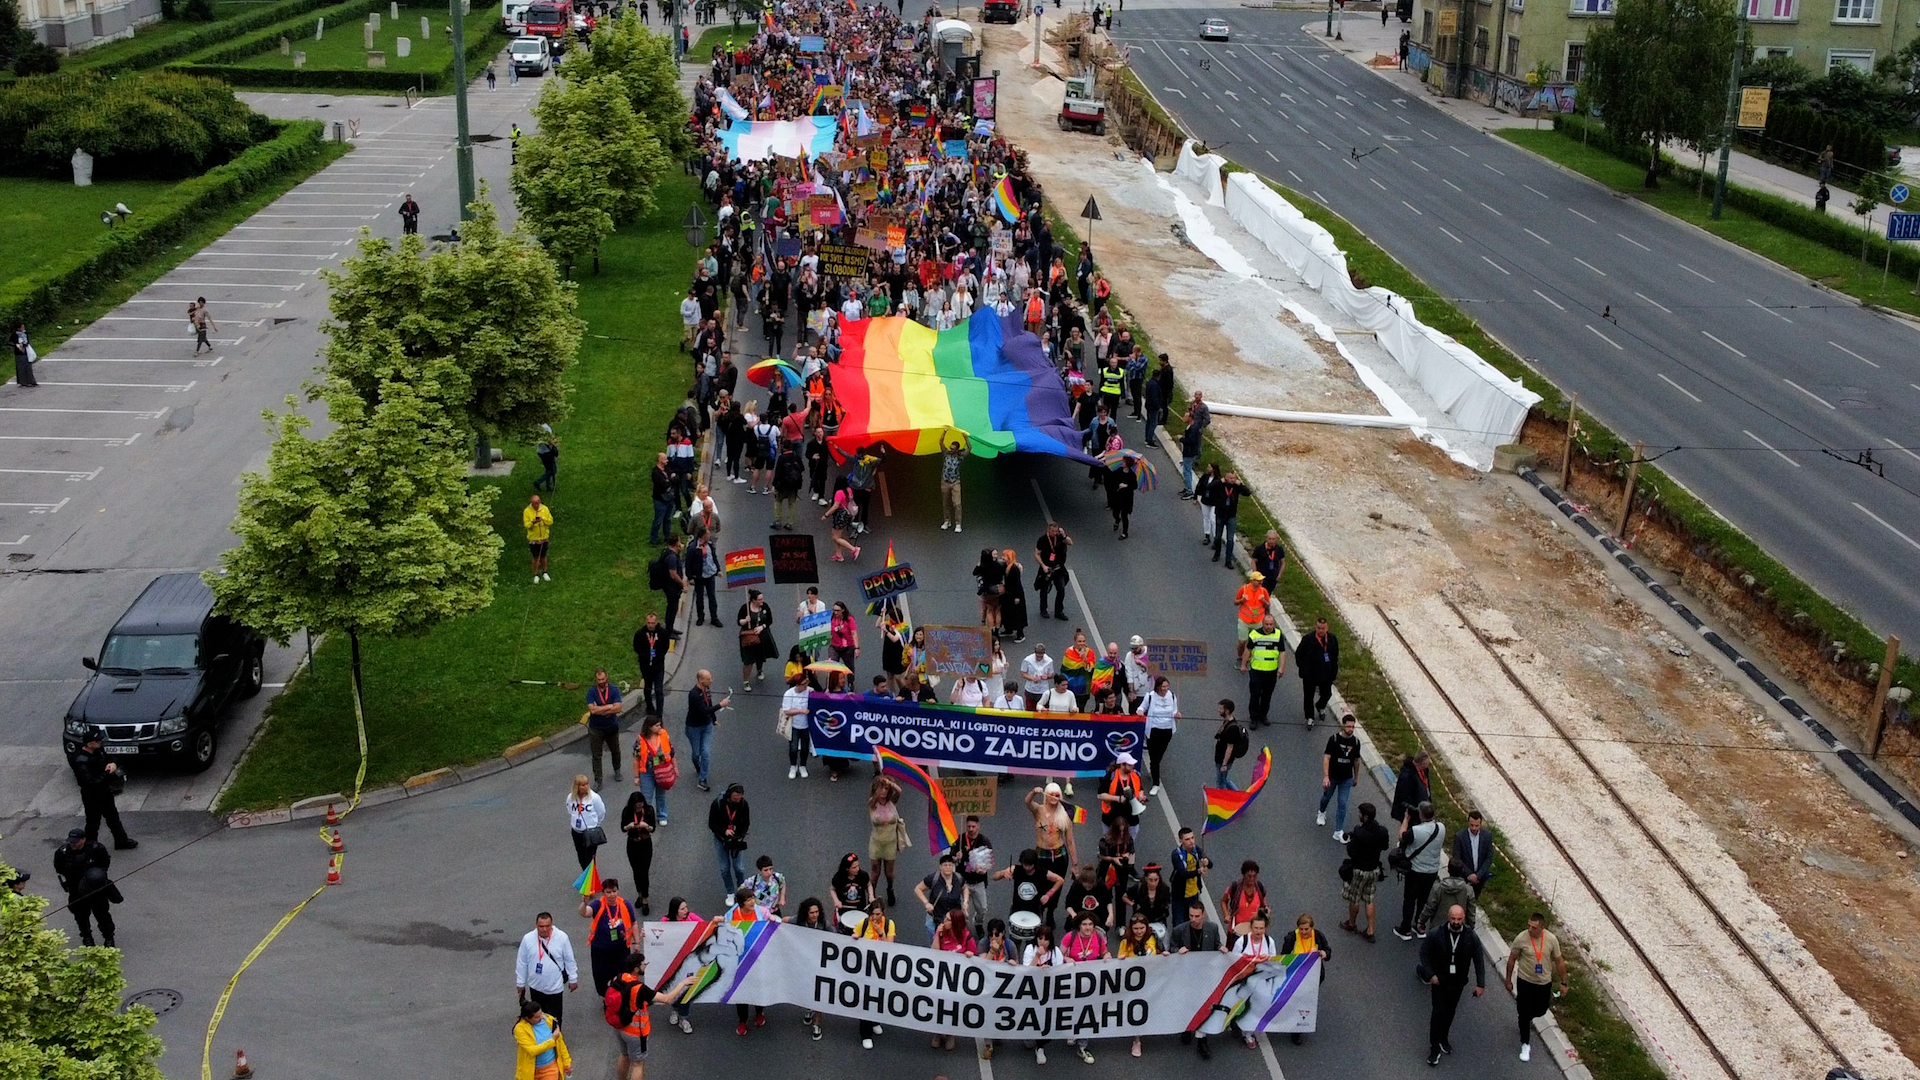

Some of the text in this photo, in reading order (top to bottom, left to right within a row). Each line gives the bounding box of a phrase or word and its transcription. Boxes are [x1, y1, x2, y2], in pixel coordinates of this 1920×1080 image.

[862, 567, 915, 599] PROUD
[850, 723, 1098, 762] PONOSNO ZAJEDNO
[854, 711, 889, 724] GRUPA
[968, 721, 1007, 734] LGBTIQ
[1008, 725, 1039, 737] DJECE
[1041, 728, 1094, 739] ZAGRLJAJ
[571, 802, 593, 812] MSC
[820, 941, 1146, 1006] PONOSNO ZAJEDNO
[814, 975, 985, 1029] ПОНОСНО
